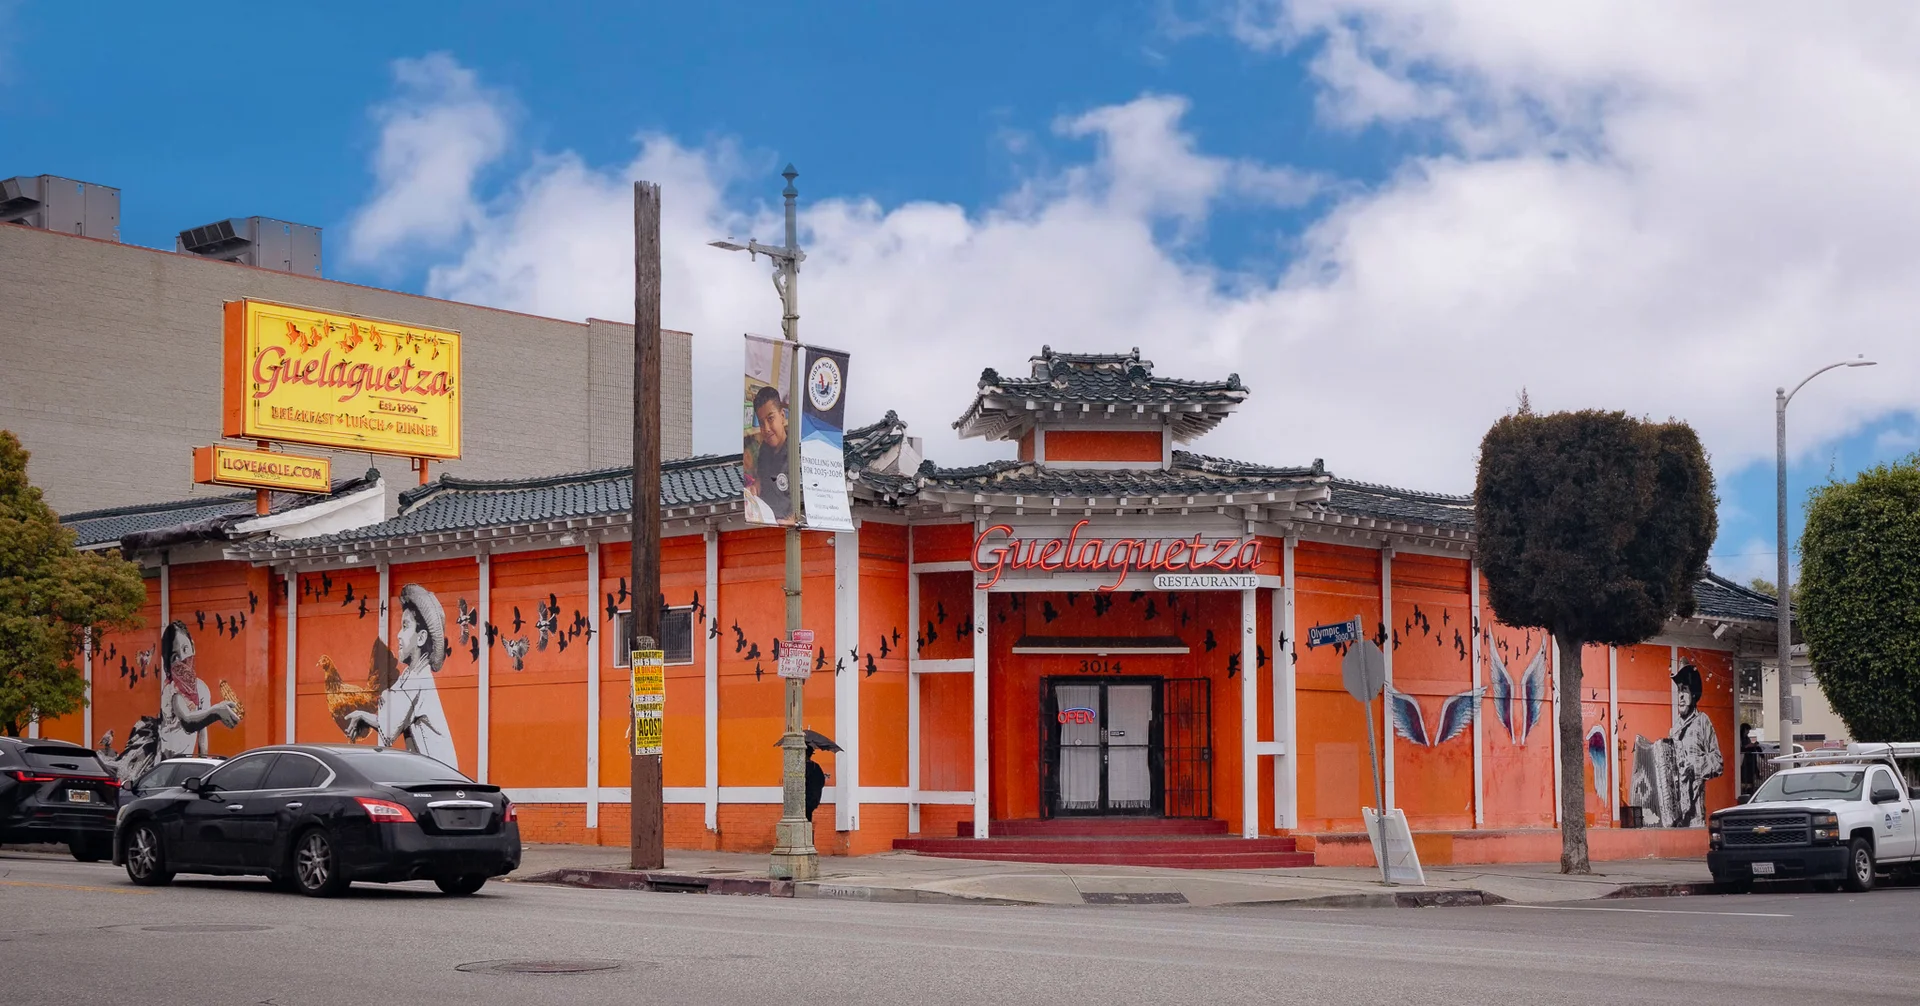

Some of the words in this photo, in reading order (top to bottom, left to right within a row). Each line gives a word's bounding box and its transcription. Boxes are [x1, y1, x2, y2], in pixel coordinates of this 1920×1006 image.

[252, 345, 454, 403] Guelaguetza
[811, 364, 822, 381] VISTA
[822, 362, 839, 385] HORIZON
[379, 400, 396, 411] Est.
[271, 405, 335, 426] BREAKFAST
[345, 413, 385, 432] LUNCH
[395, 421, 438, 437] DINNER
[223, 457, 322, 480] ILOVEMOLE.COM
[801, 456, 830, 468] ENROLLING
[830, 460, 843, 468] NOW
[803, 466, 814, 475] FOR
[814, 467, 843, 478] 2025-2026
[970, 519, 1265, 592] Guelaguetza
[1157, 576, 1257, 588] RESTAURANTE
[1310, 626, 1340, 641] Olympic
[1079, 660, 1123, 674] 3014
[1058, 709, 1094, 725] OPEN
